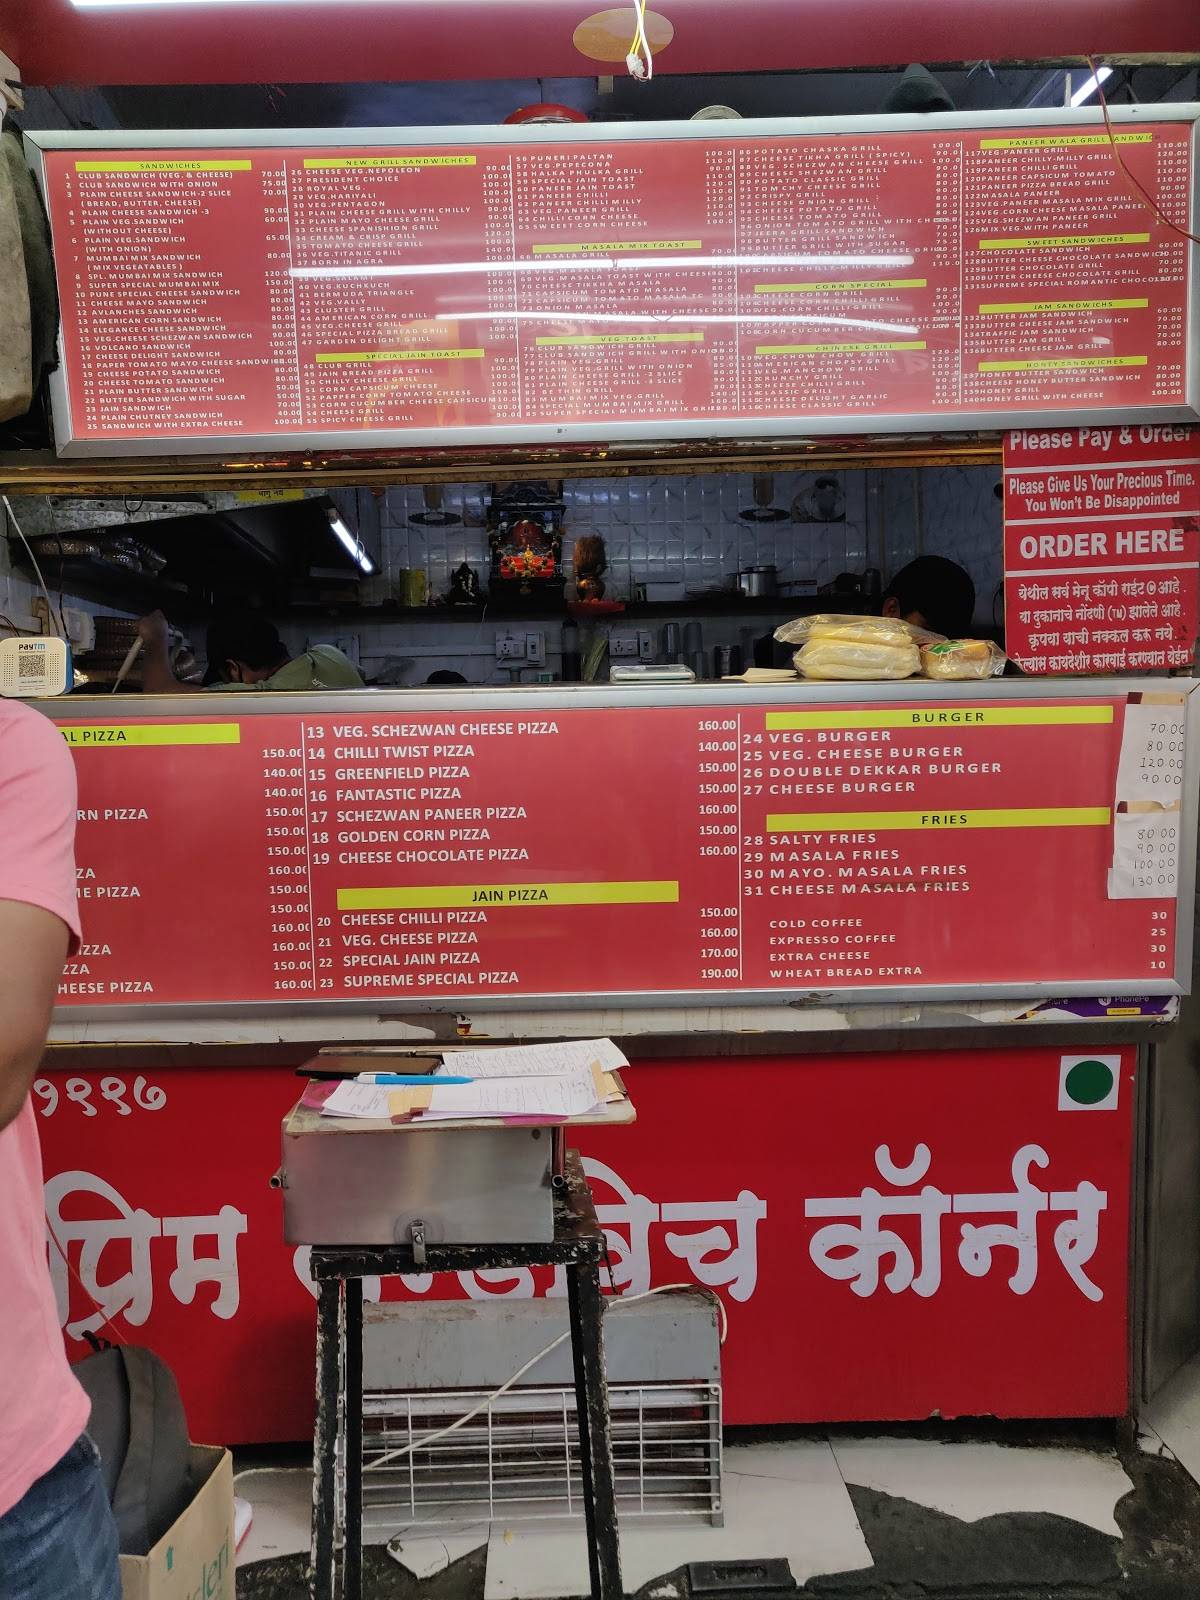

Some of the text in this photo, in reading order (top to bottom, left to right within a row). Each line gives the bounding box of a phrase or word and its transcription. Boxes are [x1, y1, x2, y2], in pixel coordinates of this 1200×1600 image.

[402, 156, 467, 164] SANDWICHES
[1061, 237, 1124, 245] SANDWICHES
[1011, 423, 1189, 451] Please Pay & Order
[1010, 470, 1194, 494] Please Give Us Your Precious Time.
[1026, 491, 1179, 511] You Won't Be Disappointed
[1019, 528, 1185, 560] ORDER HERE
[913, 713, 983, 722] BURGER
[308, 720, 736, 738] 13 VEG. SCHEZWAN CHEESE PIZZA 160.00
[83, 731, 126, 741] PIZZA
[743, 731, 890, 743] 24 VEG. BURGER
[309, 742, 736, 759] 14 CHILLI TWIST PIZZA 140.00
[744, 747, 962, 760] 25 VEG. CHEESE BURGER
[309, 763, 736, 780] 15 GREENFIELD PIZZA 150.00
[744, 763, 1000, 778] 26 DOUBLE DEKKAR BURGER
[744, 782, 914, 795] 27 CHEESE BURGER
[105, 809, 148, 819] PIZZA
[922, 815, 967, 824] FRIES
[744, 834, 875, 845] 28 SALTY FRIES
[313, 846, 737, 864] 19 CHEESE CHOCOLATE PIZZA 160.00
[745, 865, 966, 879] 30 MAYO. MASALA FRIES
[97, 887, 140, 897] PIZZA
[473, 890, 548, 901] JAIN PIZZA
[318, 908, 737, 926] 20 CHEESE CHILLI PIZZA 150.00
[770, 920, 805, 928] COLD
[812, 919, 861, 927] COFFEE
[770, 928, 1166, 944] EXPRESSO COFFEE 25
[320, 948, 738, 967] 22 SPECIAL JAIN PIZZA 170.00
[320, 969, 738, 987] 23 SUPREME SPECIAL PIZZA 190.00
[770, 969, 821, 977] WHEAT
[827, 968, 872, 976] BREAD
[879, 967, 921, 975] EXTRA
[58, 982, 153, 993] HEESE PIZZA
[805, 1143, 1107, 1302] कॉर्नर
